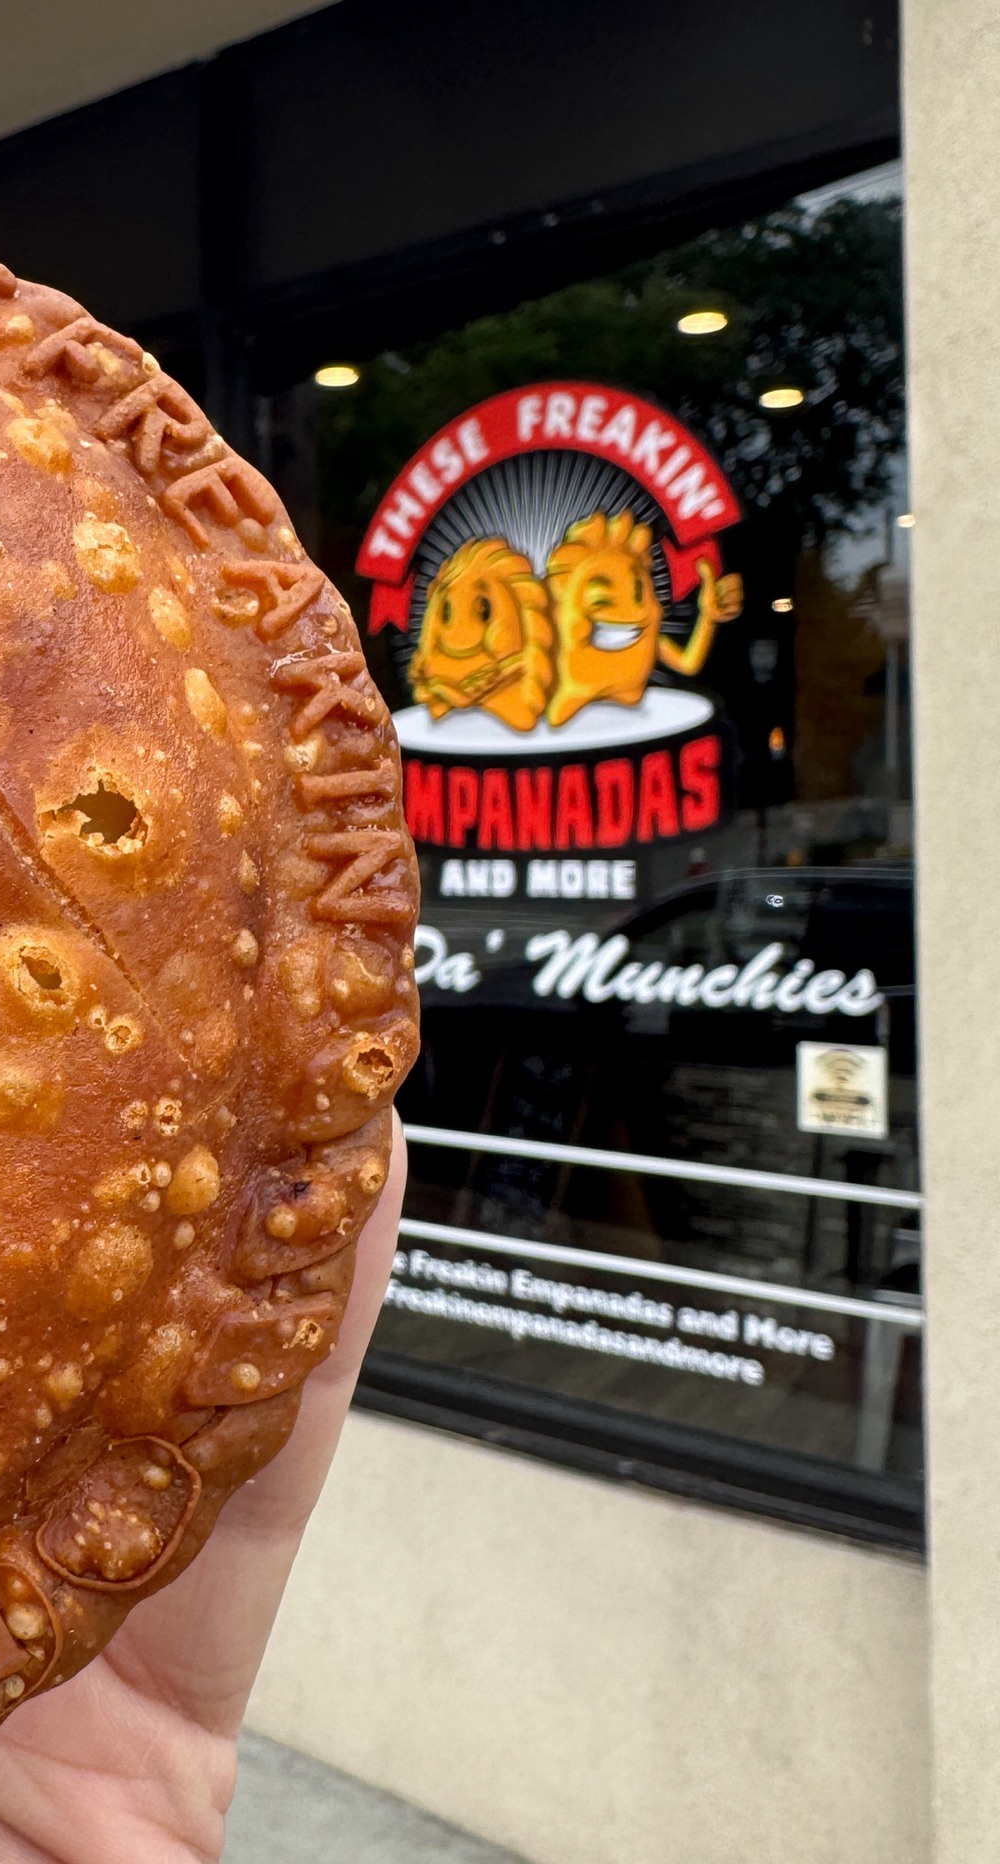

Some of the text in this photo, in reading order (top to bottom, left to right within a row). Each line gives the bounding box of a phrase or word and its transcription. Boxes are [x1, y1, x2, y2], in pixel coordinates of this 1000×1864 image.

[366, 390, 726, 560] THESE FREAKIN'
[405, 735, 723, 852] MPANADAS
[439, 858, 637, 900] AND MORE
[524, 928, 886, 1017] Munchies
[510, 1268, 675, 1329] Empanadas
[676, 1306, 740, 1343] and
[743, 1313, 836, 1362] More
